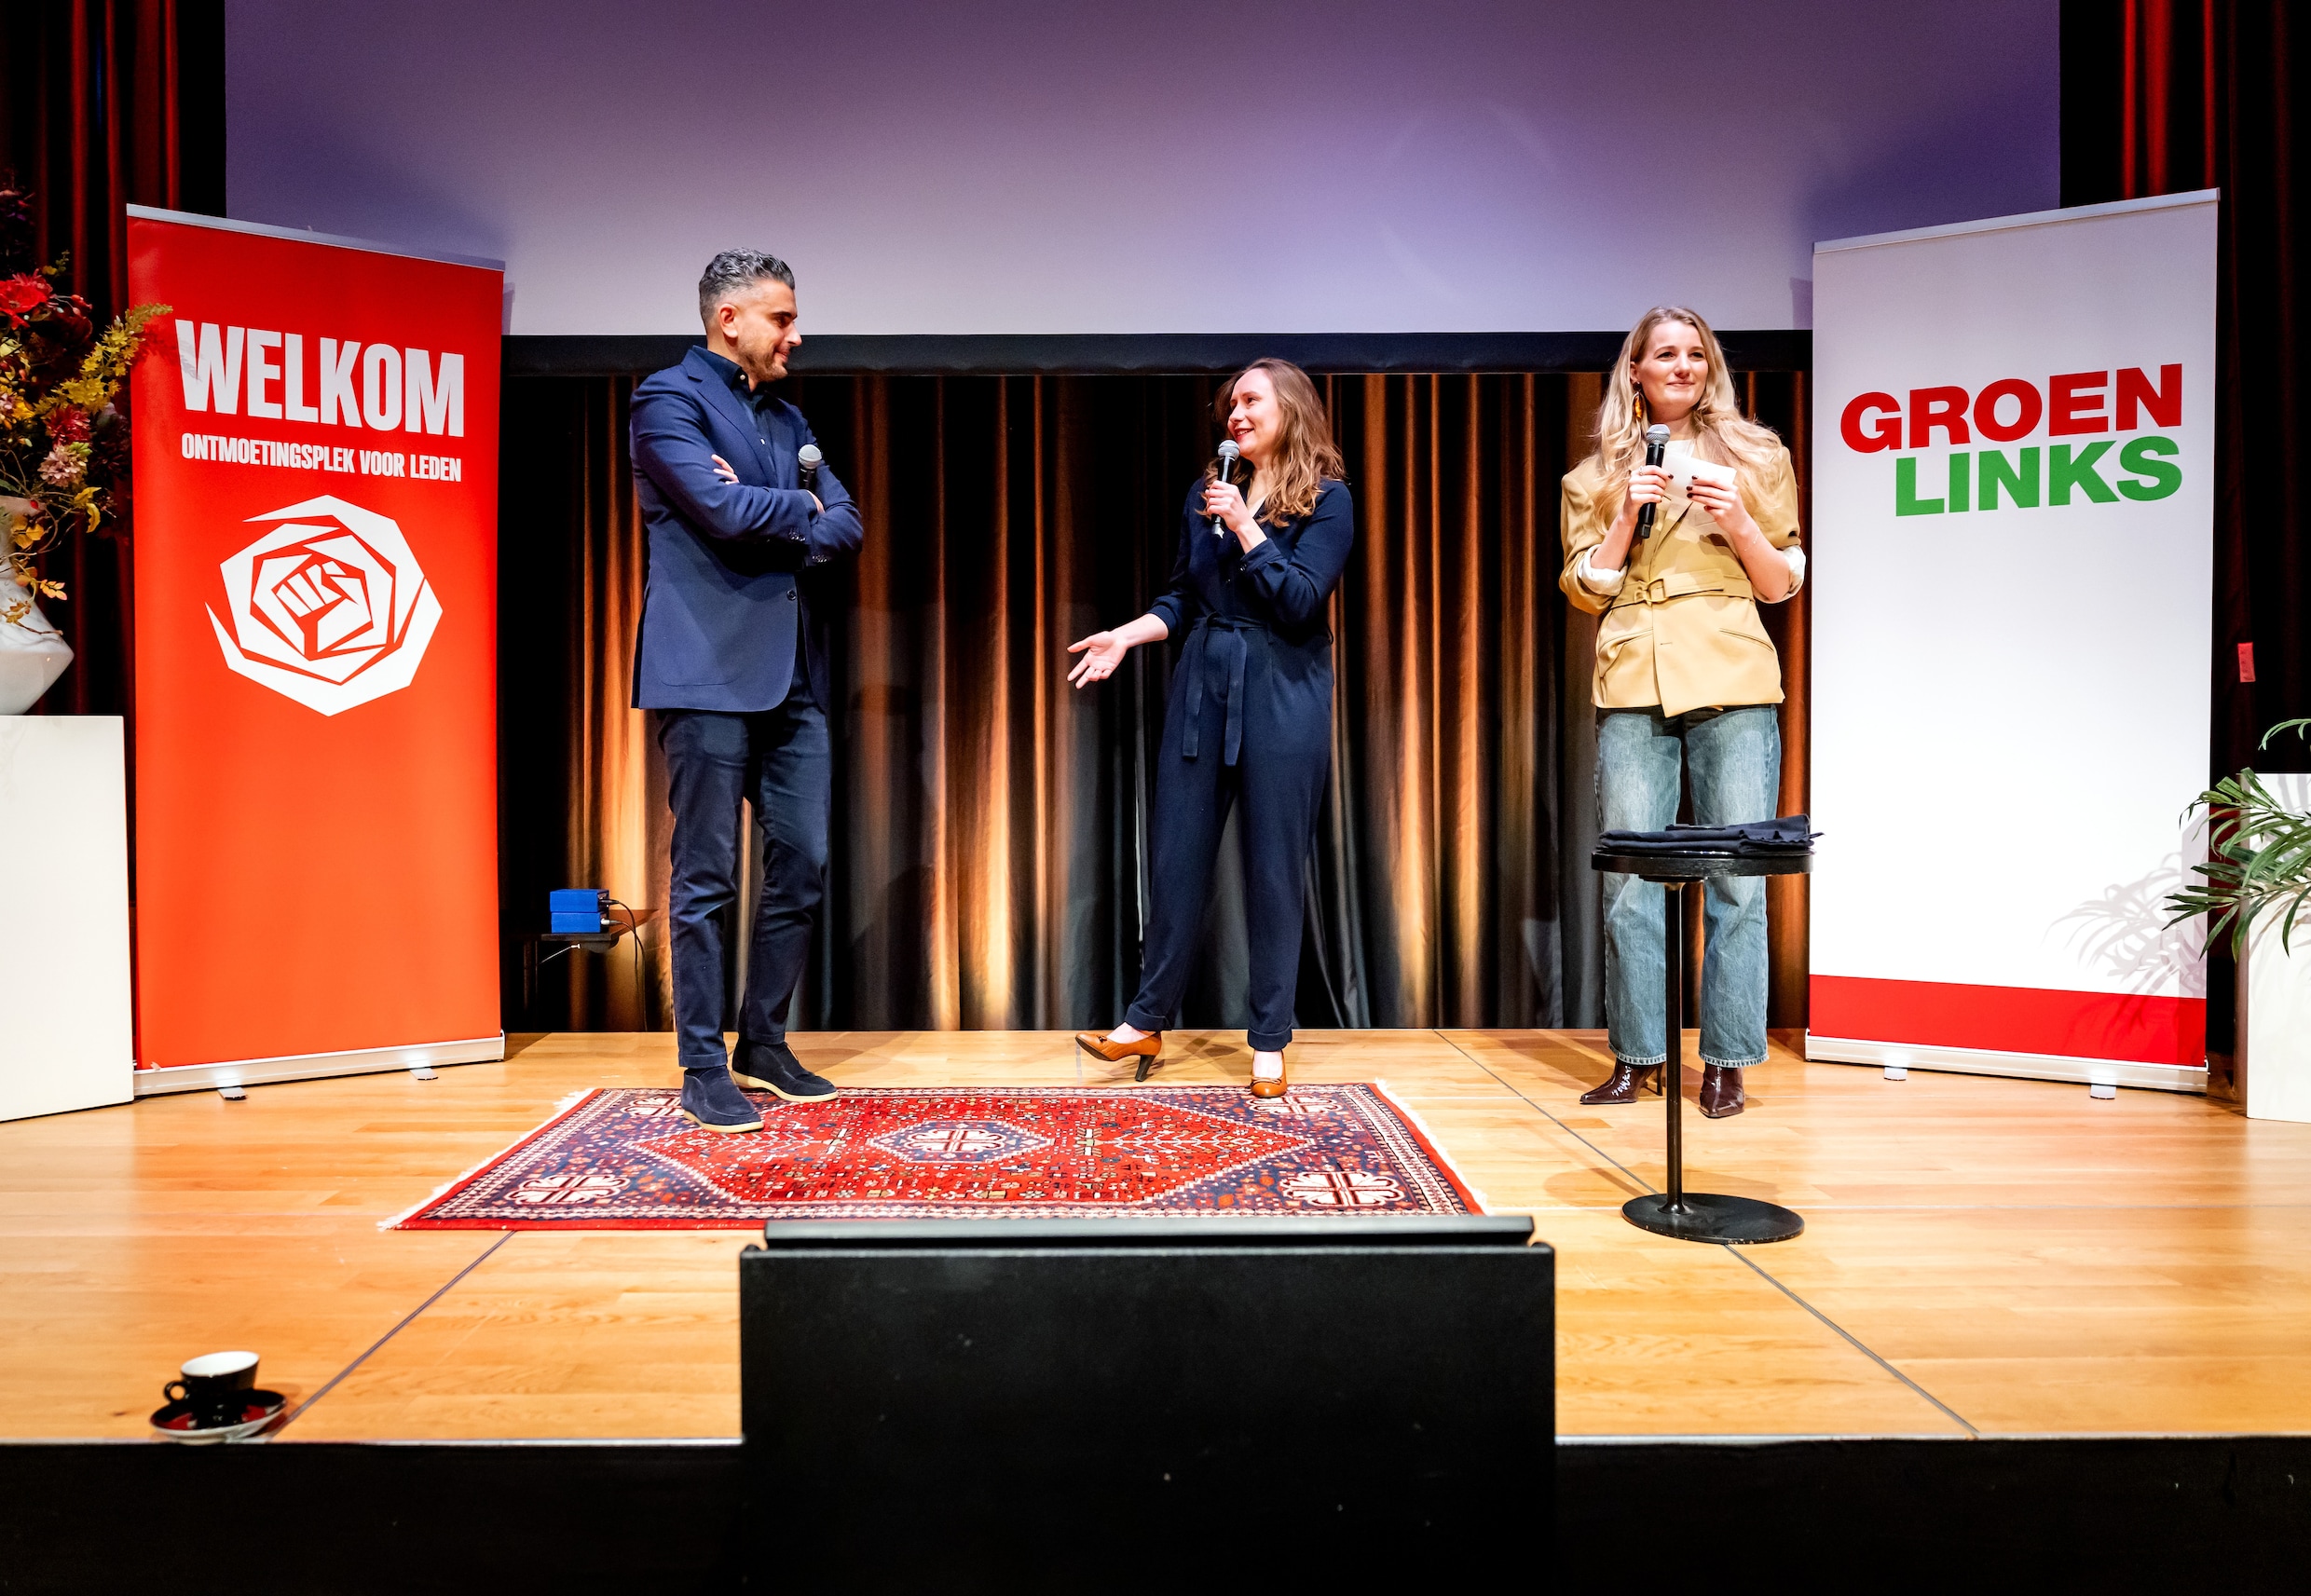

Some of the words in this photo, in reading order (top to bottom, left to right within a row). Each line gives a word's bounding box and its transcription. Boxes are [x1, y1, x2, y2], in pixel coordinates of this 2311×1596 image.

[175, 320, 464, 437] WELKOM
[1840, 363, 2181, 454] GROEN
[182, 433, 355, 473] ONTMOETINGSPLEK
[360, 449, 405, 477] VOOR
[411, 455, 461, 482] LEDEN
[1896, 436, 2181, 516] LINKS
